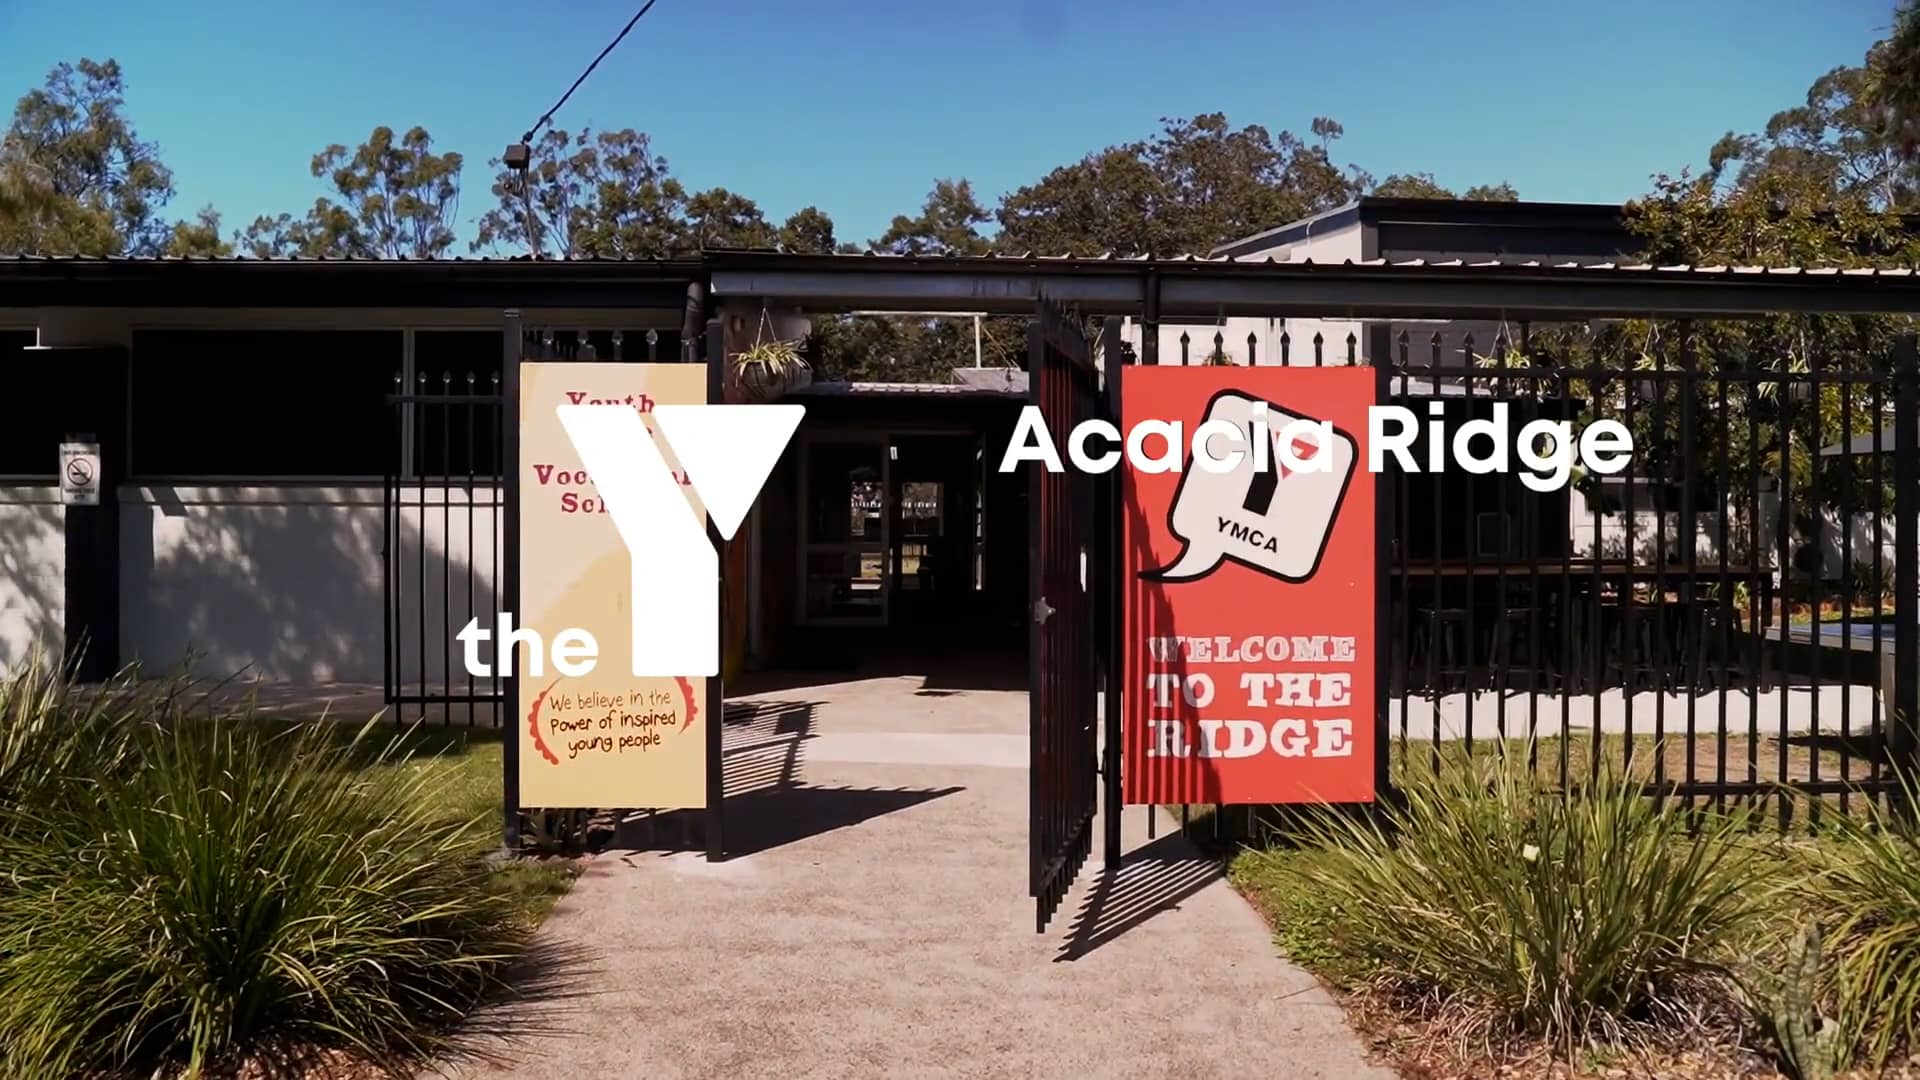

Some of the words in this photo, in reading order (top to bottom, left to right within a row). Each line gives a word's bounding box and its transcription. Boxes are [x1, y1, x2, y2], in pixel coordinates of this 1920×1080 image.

[1217, 517, 1278, 553] YMCA
[1148, 636, 1355, 663] WELCOME
[550, 693, 572, 712] We
[577, 691, 624, 709] believe
[630, 689, 644, 706] in
[649, 688, 671, 706] the
[1148, 673, 1215, 708] TO
[1240, 673, 1351, 707] THE
[599, 709, 617, 729] of
[620, 708, 676, 732] inspired
[568, 736, 613, 759] young
[619, 728, 661, 753] people
[1148, 719, 1352, 758] RIDGE
